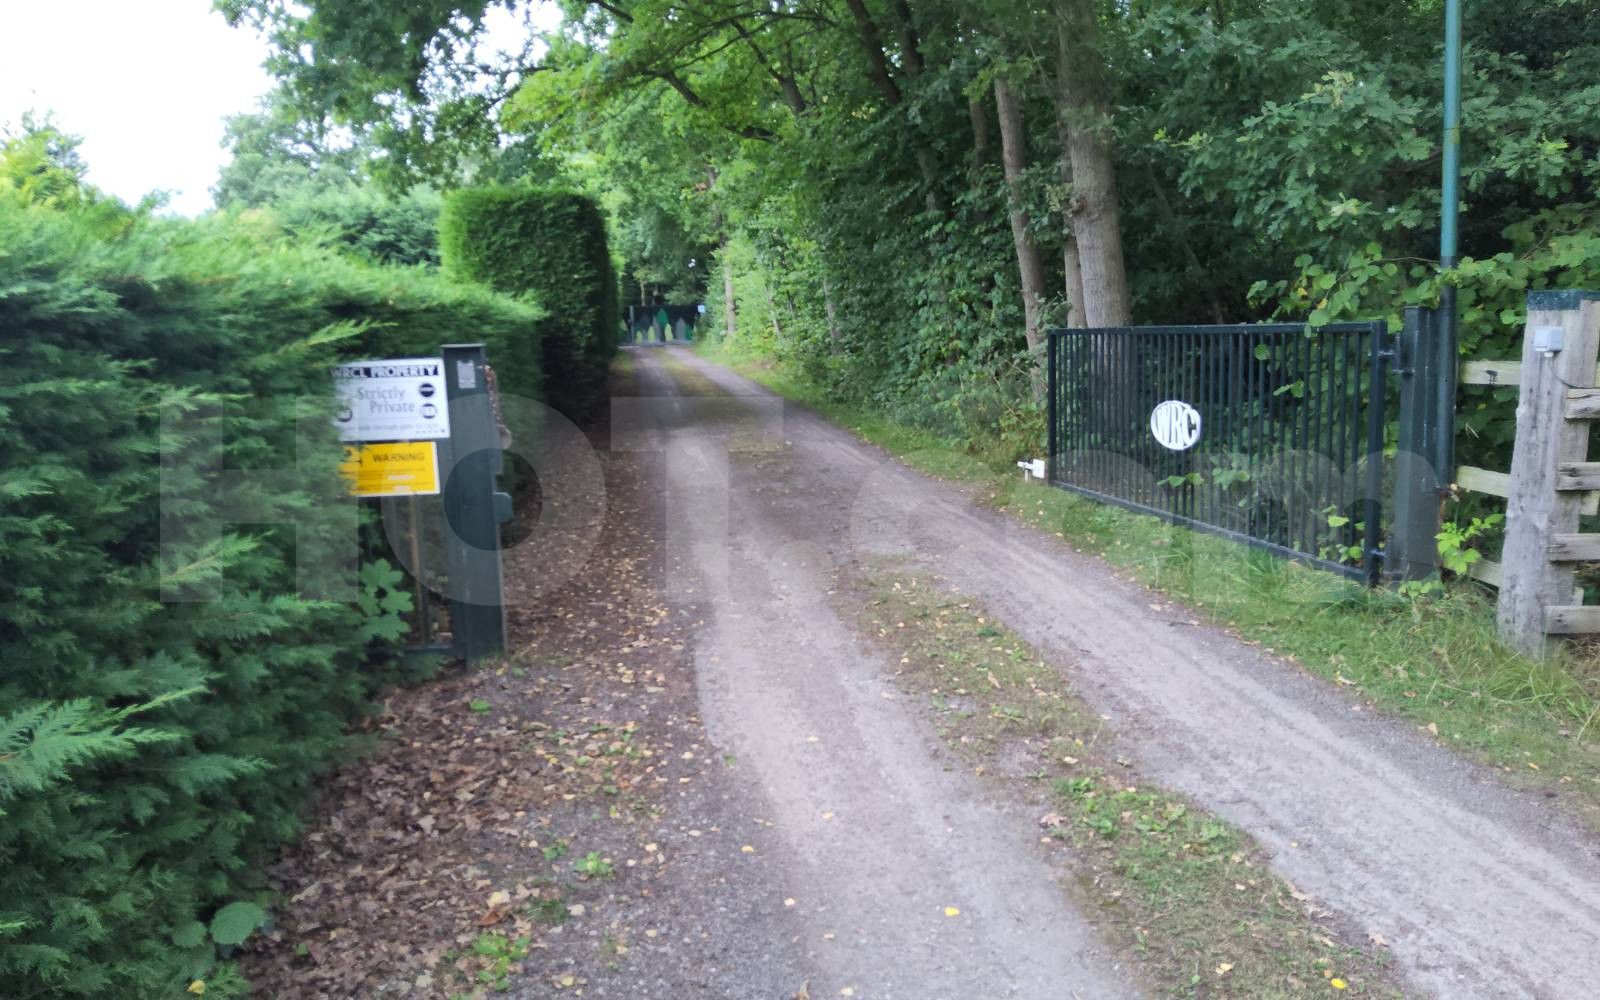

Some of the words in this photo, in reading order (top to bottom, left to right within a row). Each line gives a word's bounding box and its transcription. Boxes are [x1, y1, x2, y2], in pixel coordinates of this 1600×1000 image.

[371, 364, 439, 377] PROPERTY
[357, 386, 406, 402] Strictly
[369, 400, 416, 414] Private
[372, 452, 426, 463] WARNING
